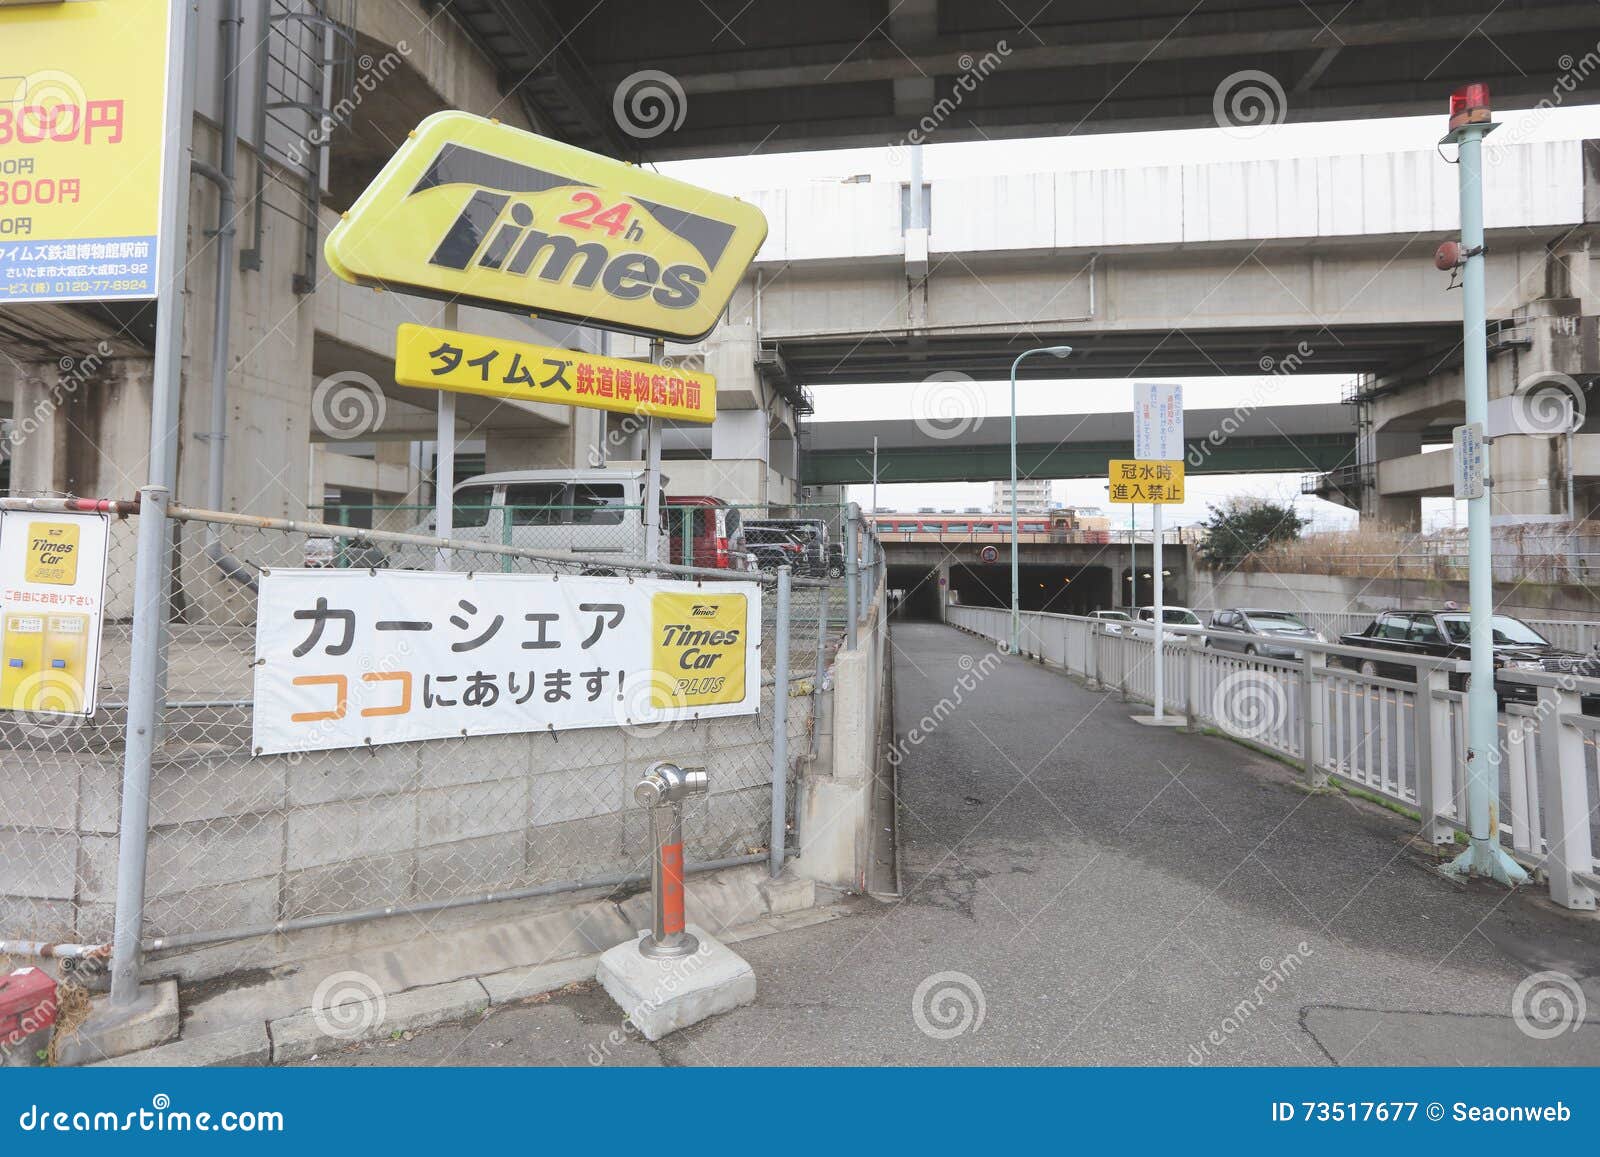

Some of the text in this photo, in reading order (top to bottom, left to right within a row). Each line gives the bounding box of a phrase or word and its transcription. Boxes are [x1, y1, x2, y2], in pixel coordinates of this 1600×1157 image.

[428, 190, 707, 310] Times
[1122, 464, 1172, 480] 冠水時
[1113, 484, 1181, 500] 進入禁止
[32, 538, 74, 554] Times
[39, 552, 64, 565] Car
[4, 591, 94, 606] ご自由にお取り下さい
[292, 596, 627, 658] カーシェア
[662, 624, 740, 647] Times
[679, 648, 723, 670] Car
[672, 677, 725, 697] PLUS
